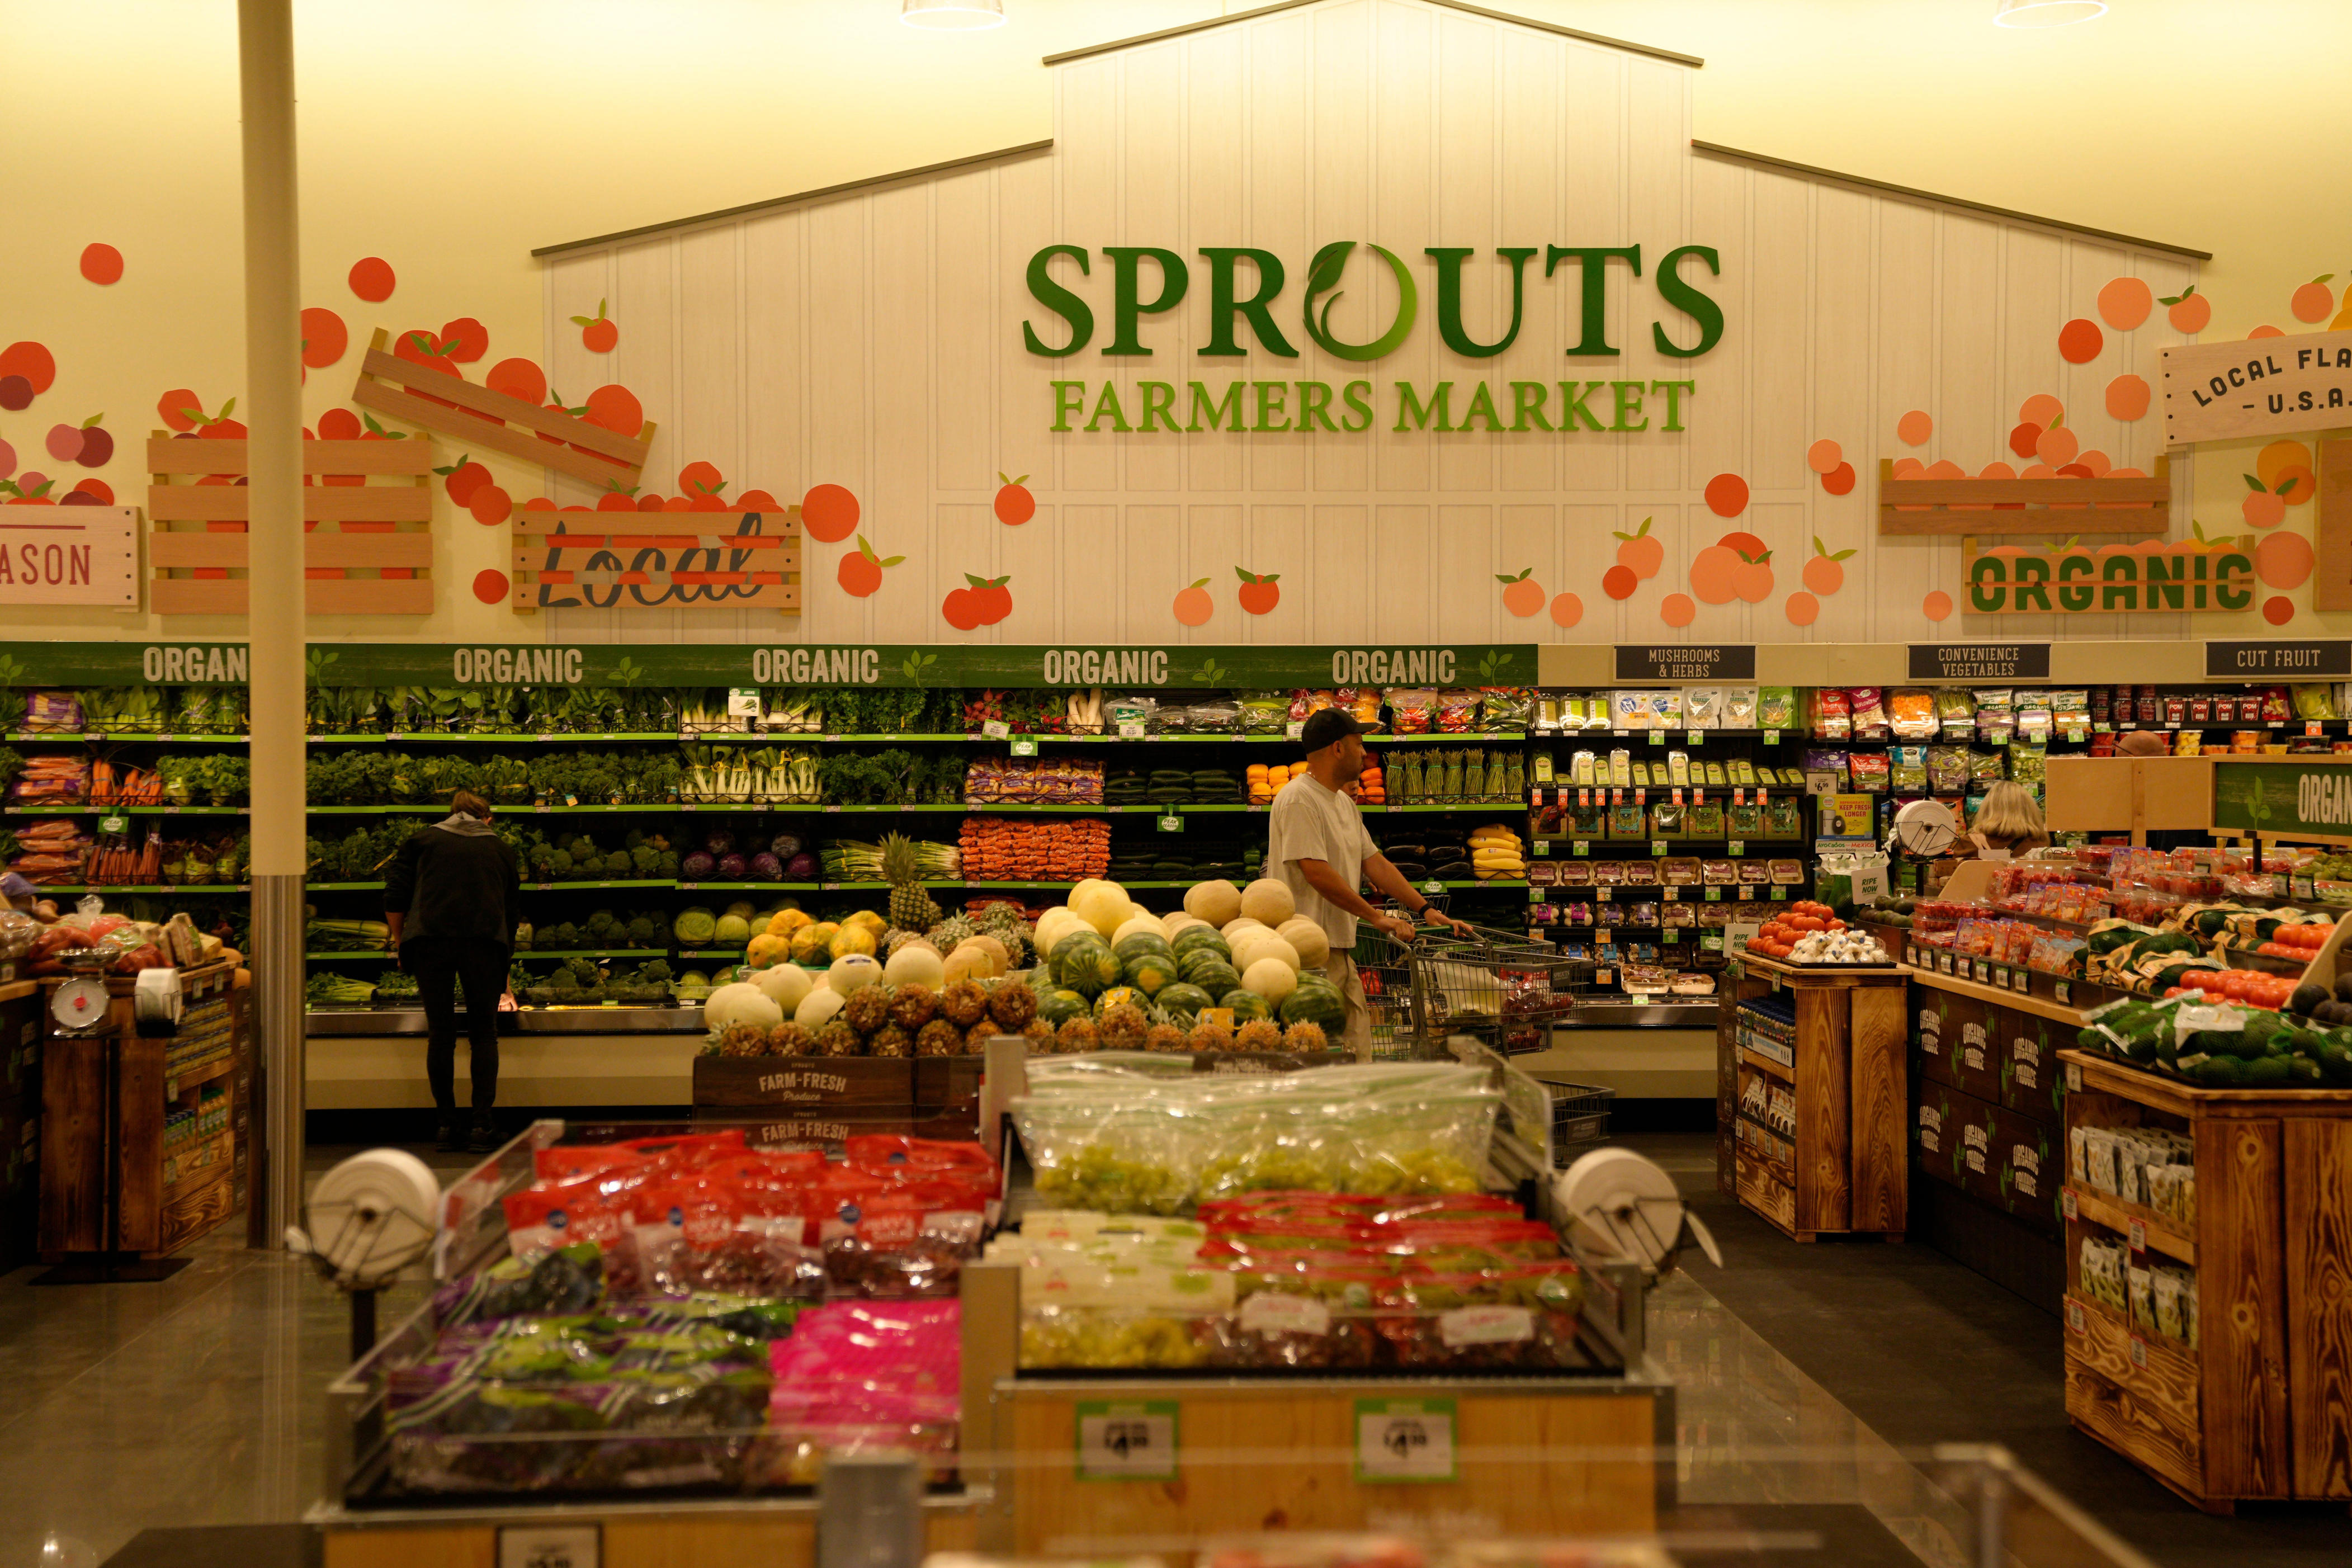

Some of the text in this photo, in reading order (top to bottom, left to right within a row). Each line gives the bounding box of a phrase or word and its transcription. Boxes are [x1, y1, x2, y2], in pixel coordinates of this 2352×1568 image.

[1023, 242, 1724, 360] SPROUTS
[2192, 348, 2351, 407] LOCAL FLA
[1050, 379, 1694, 432] FARMERS MARKET
[538, 512, 764, 608] Local
[1971, 554, 2252, 612] ORGANIC
[454, 649, 583, 683] ORGANIC
[753, 649, 878, 683] ORGANIC
[1044, 650, 1168, 684] ORGANIC
[1333, 650, 1456, 684] ORGANIC
[1649, 649, 1720, 662] MUSHROOMS
[1938, 648, 2019, 661] CONVENIENCE
[2237, 649, 2321, 667] CUT FRUIT
[1659, 665, 1709, 678] & HERBS
[1943, 663, 2014, 677] VEGETABLES
[1862, 877, 1877, 886] RIPE
[1862, 885, 1878, 894] NOW
[1920, 1009, 1940, 1035] ORGANIC
[1921, 1033, 1938, 1055] PRODUCE
[1963, 1022, 1986, 1050] ORGANIC
[1965, 1047, 1984, 1071] PRODUCE
[2014, 1037, 2039, 1068] ORGANIC
[759, 1072, 847, 1093] FARM-FRESH
[2015, 1064, 2036, 1089] PRODUCE
[783, 1090, 821, 1101] Produce
[762, 1121, 849, 1142] FARM-FRESH
[1920, 1106, 1940, 1133] ORGANIC
[1921, 1130, 1939, 1153] PRODUCE
[1964, 1124, 1987, 1154] ORGANIC
[1966, 1150, 1986, 1174] PRODUCE
[2013, 1144, 2038, 1176] ORGANIC
[2015, 1171, 2036, 1198] PRODUCE
